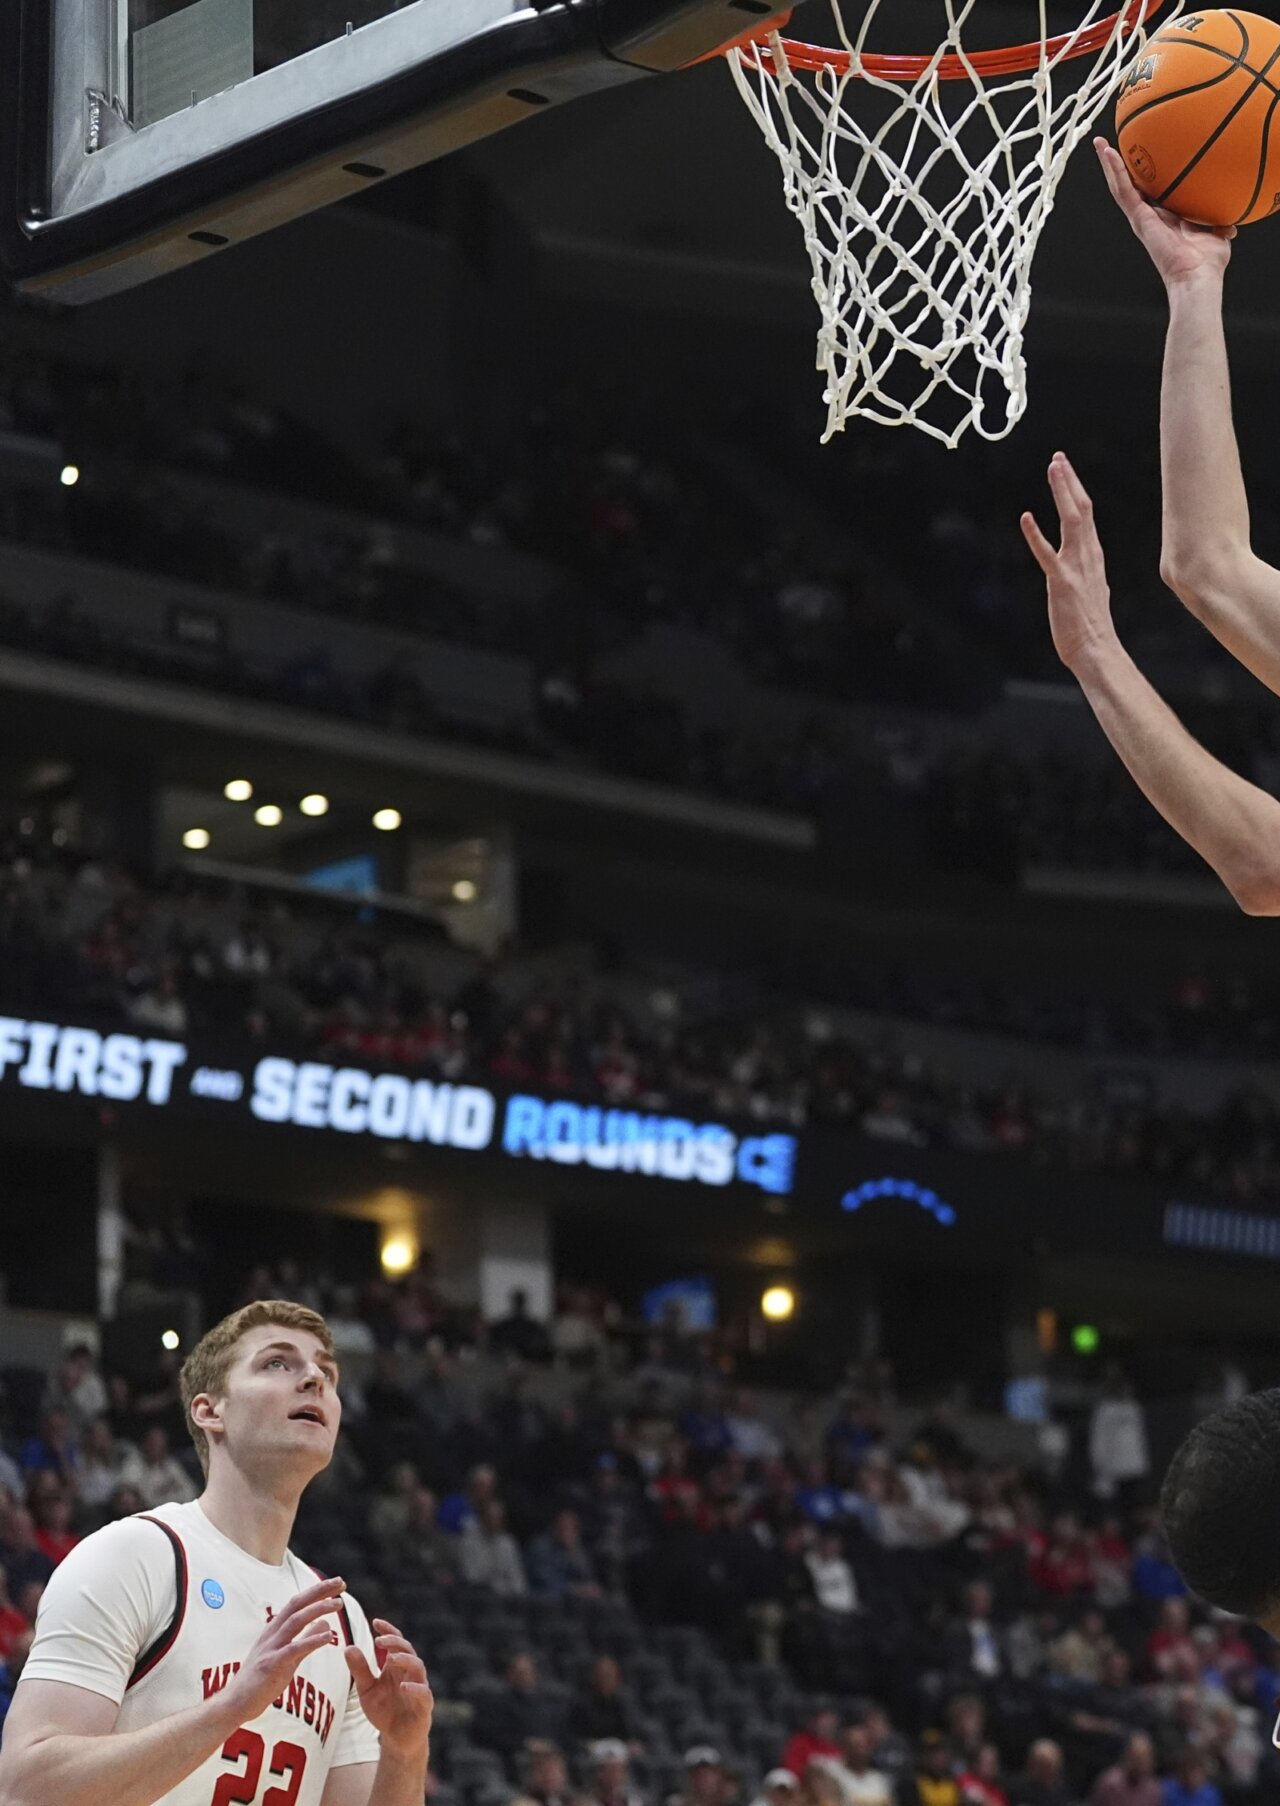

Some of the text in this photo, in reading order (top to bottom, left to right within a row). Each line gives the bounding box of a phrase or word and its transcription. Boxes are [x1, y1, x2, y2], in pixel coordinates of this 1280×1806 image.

[0, 1016, 187, 1106] FIRST
[250, 1056, 496, 1150] SECOND
[503, 1093, 738, 1187] ROUNDS
[210, 1727, 308, 1806] 22
